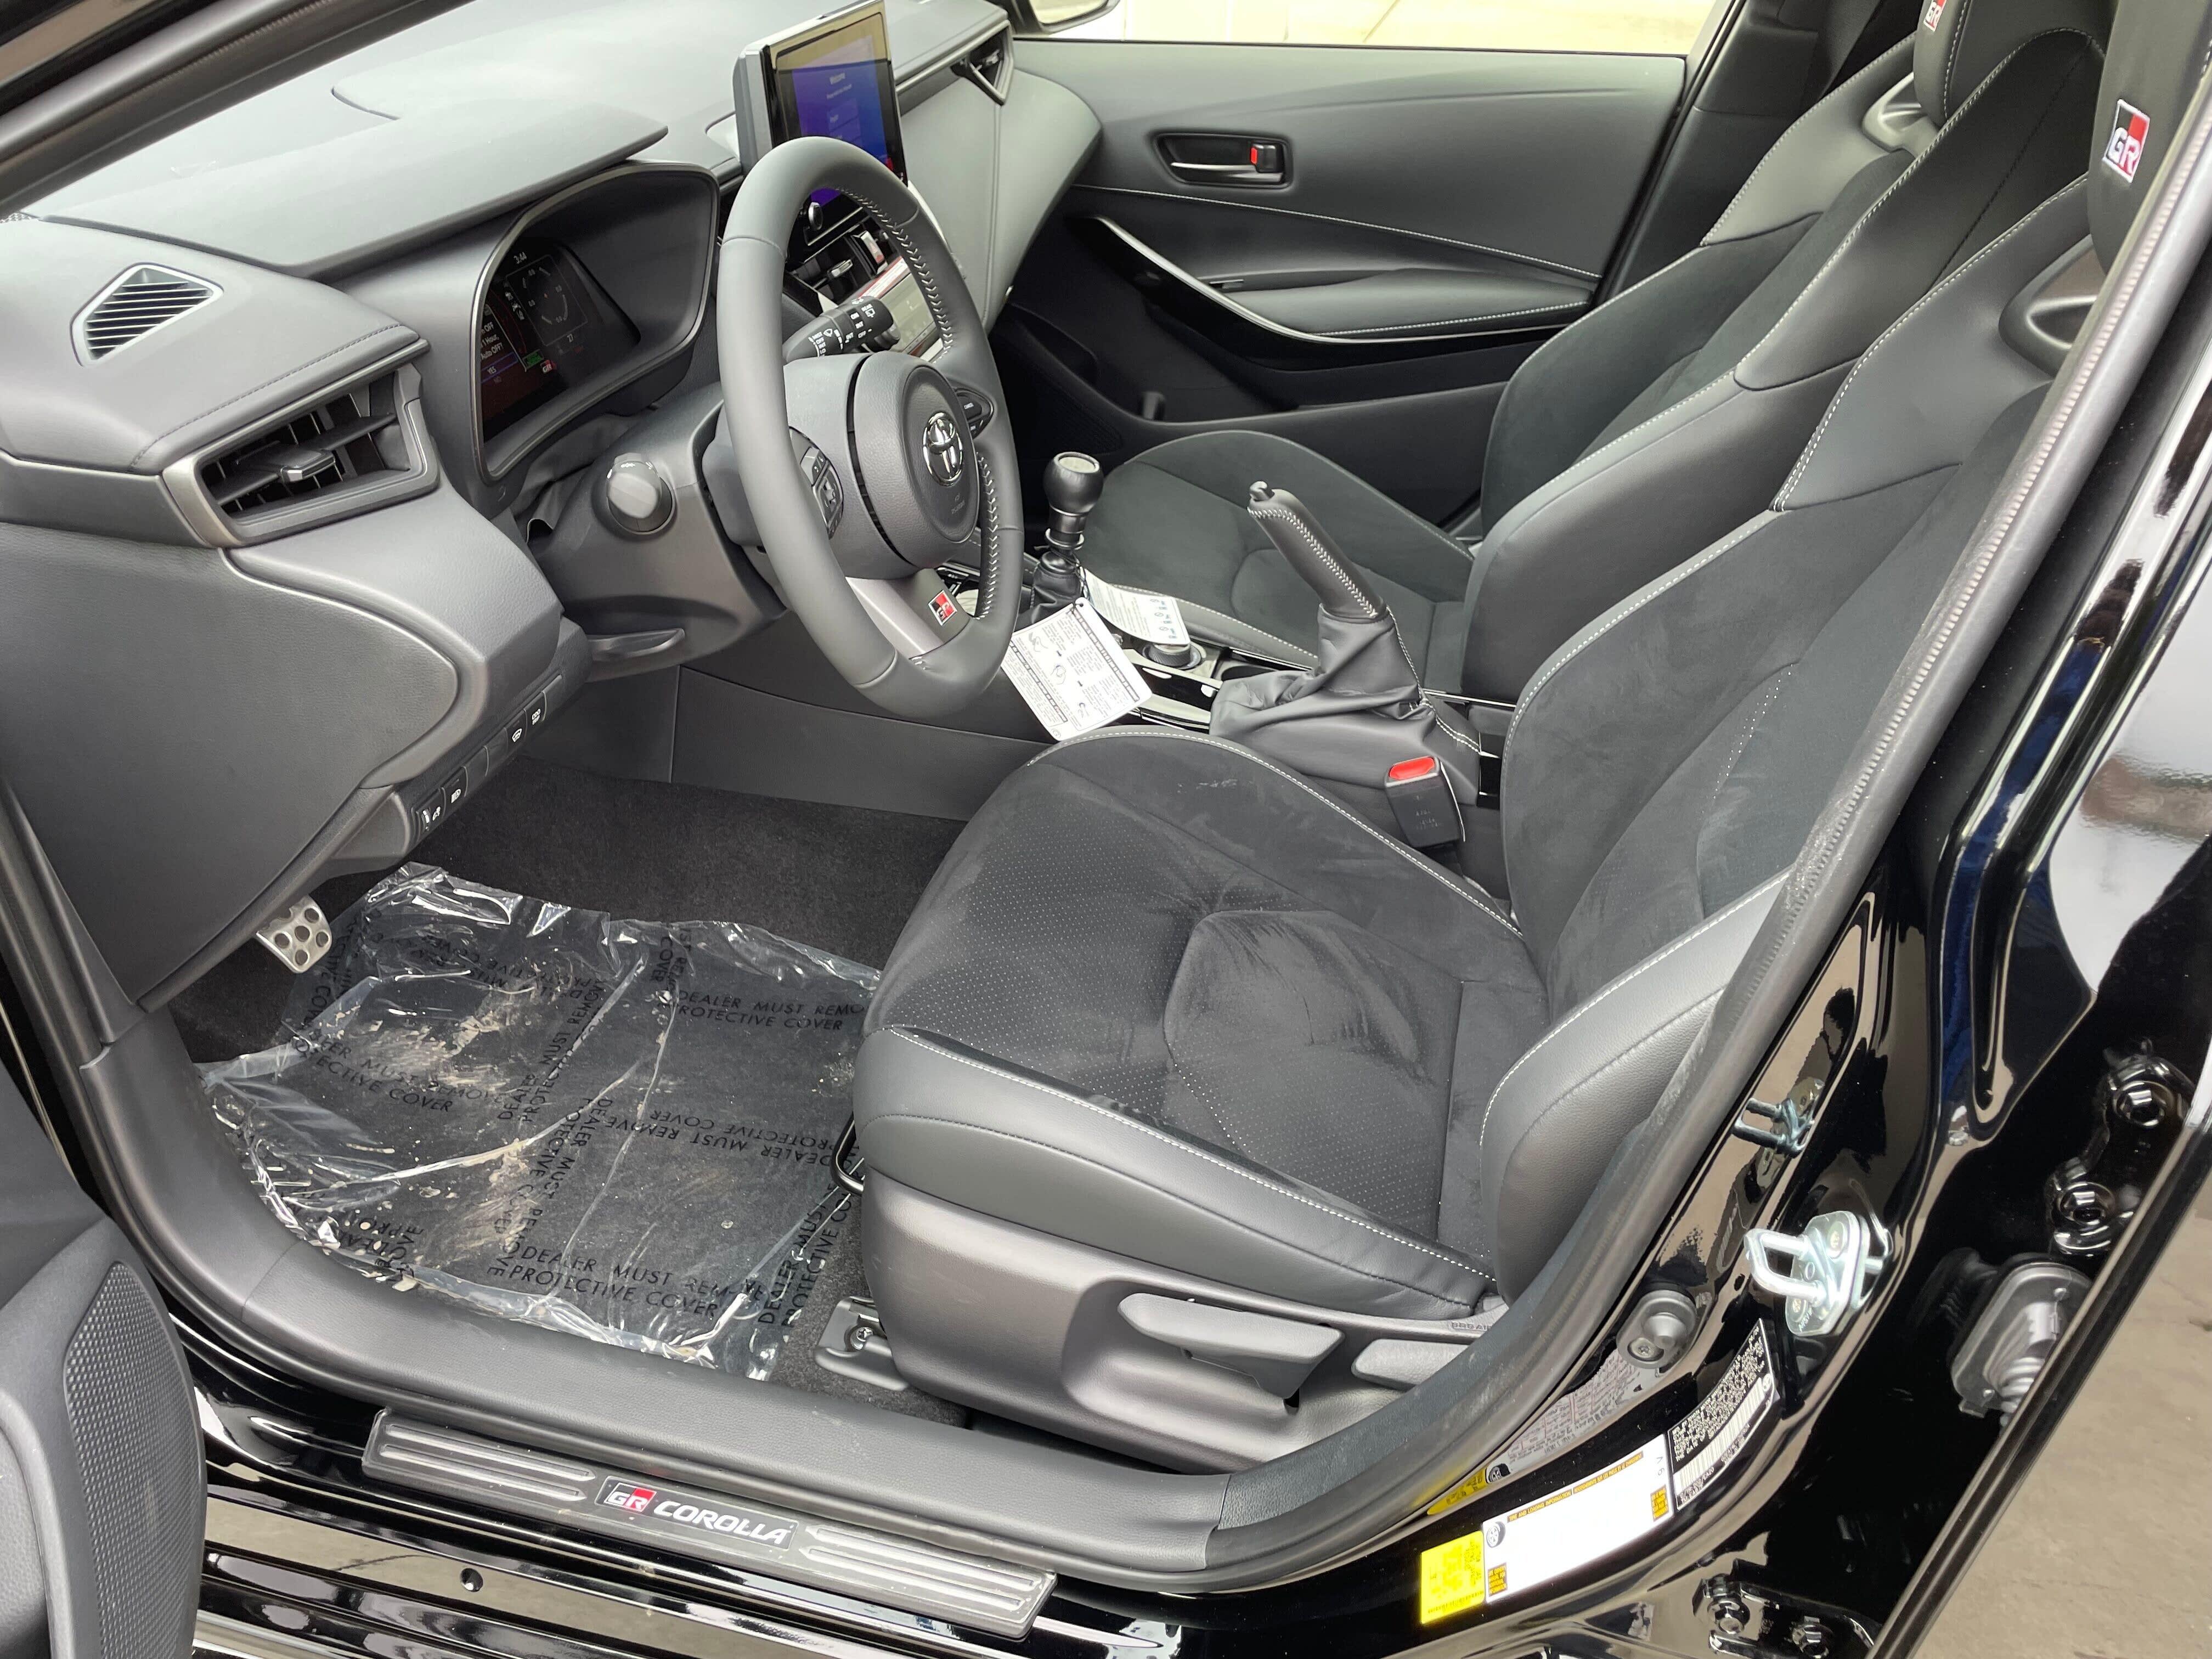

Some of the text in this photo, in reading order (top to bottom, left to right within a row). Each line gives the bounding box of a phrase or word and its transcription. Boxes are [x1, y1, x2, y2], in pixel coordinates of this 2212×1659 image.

[2108, 127, 2141, 176] GR
[484, 321, 494, 332] OFF
[487, 366, 496, 374] YES
[651, 936, 673, 982] COVER
[679, 990, 867, 1016] DEALER MUST REMO
[670, 1004, 843, 1030] ROTECTIVE COVER
[390, 1088, 453, 1113] COVER
[571, 1098, 613, 1147] DEALER
[650, 1109, 715, 1129] COVER
[690, 1131, 748, 1152] MUST
[614, 1265, 674, 1286] MUST
[509, 1265, 718, 1318] PROTECTIVE COVER
[607, 1491, 792, 1545] GR COROLLA
